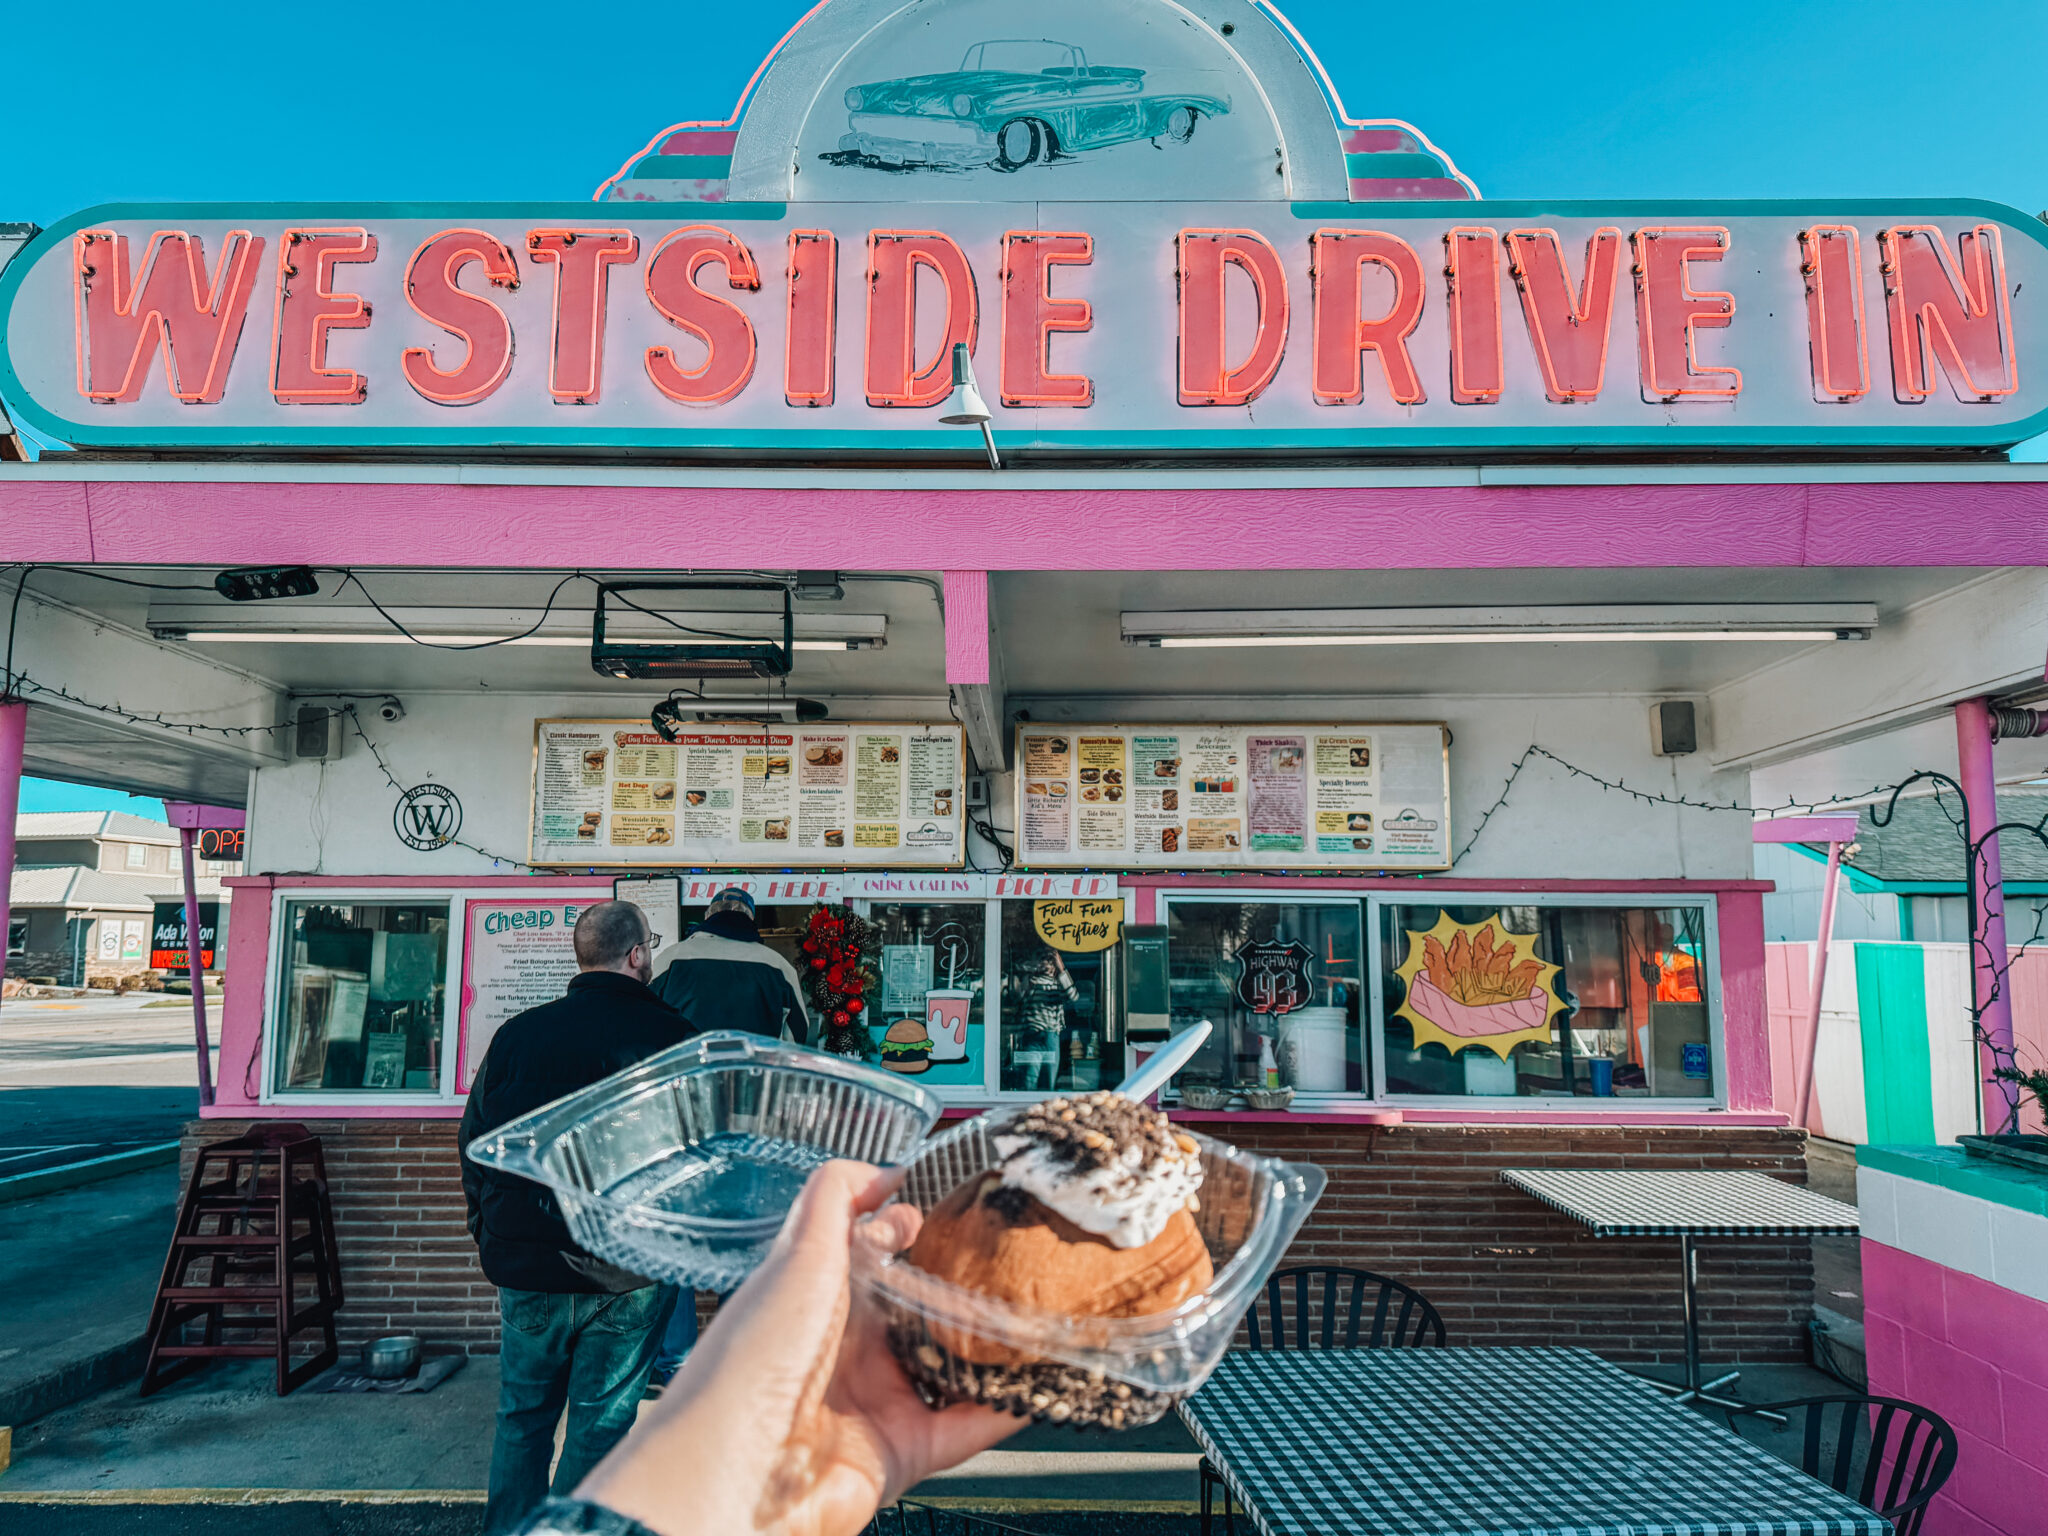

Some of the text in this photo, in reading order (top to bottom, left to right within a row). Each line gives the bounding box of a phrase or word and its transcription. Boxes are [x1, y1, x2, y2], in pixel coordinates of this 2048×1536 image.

[76, 222, 2019, 408] WESTSIDE DRIVE IN
[405, 785, 454, 802] WESTSIDE
[404, 805, 450, 838] W
[621, 816, 666, 825] Westside Dips
[768, 881, 834, 899] HERE
[864, 879, 905, 891] ONLINE
[919, 879, 948, 891] CALL
[951, 879, 970, 891] INS
[996, 878, 1109, 896] PICK-UP
[1037, 899, 1113, 919] Food Fun
[484, 910, 555, 934] Cheap
[154, 922, 215, 941] Ada Von
[1042, 919, 1109, 946] & Fifties
[161, 940, 207, 948] CENR
[530, 958, 556, 966] Bologna
[1250, 955, 1299, 970] HIGHWAY
[508, 994, 528, 1002] Turkey
[1253, 966, 1298, 1014] 93
